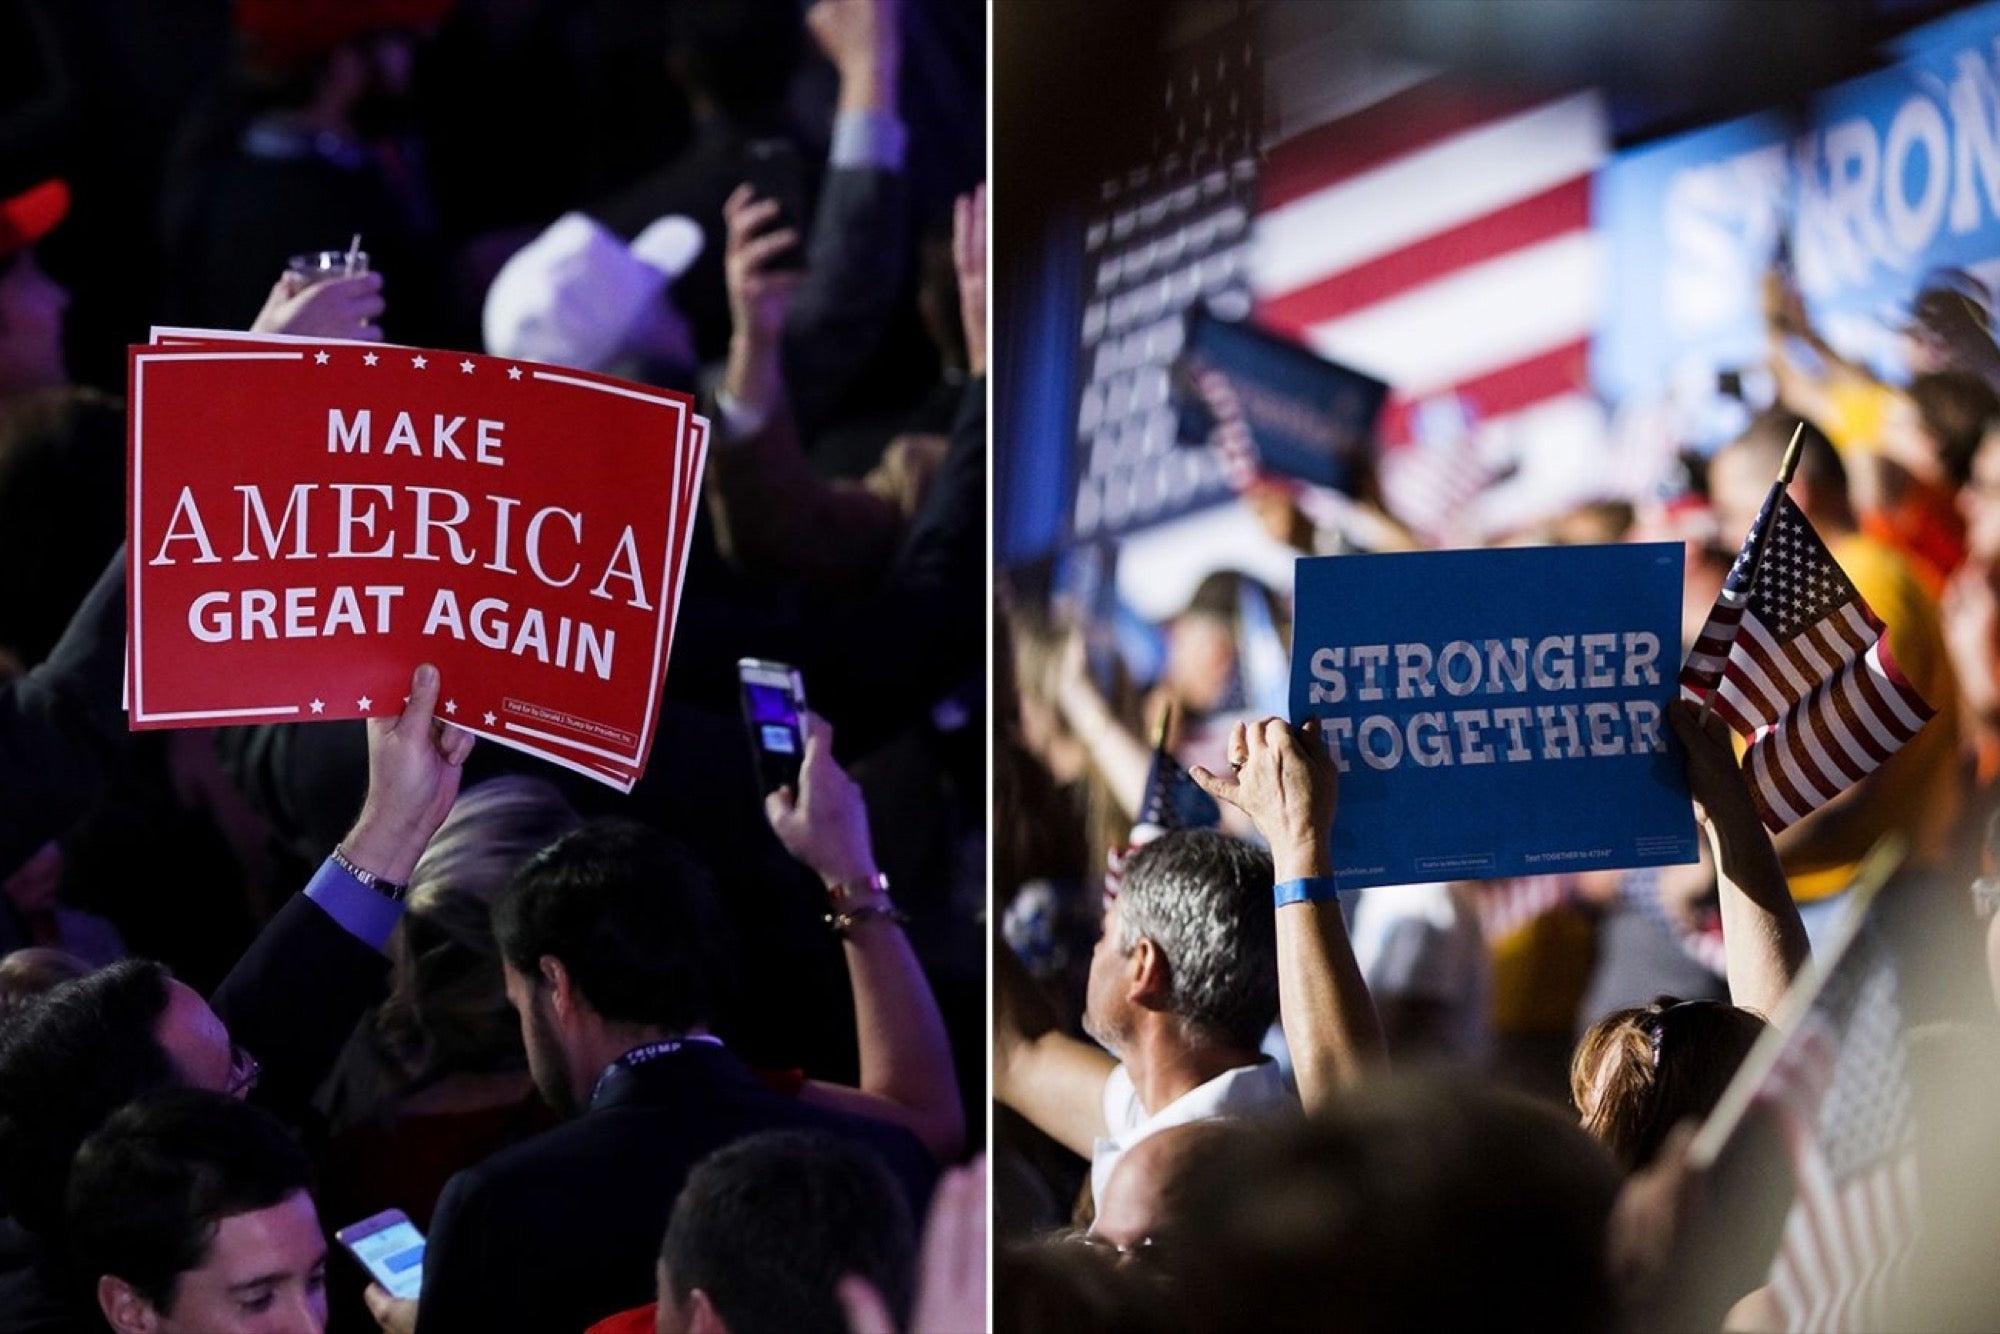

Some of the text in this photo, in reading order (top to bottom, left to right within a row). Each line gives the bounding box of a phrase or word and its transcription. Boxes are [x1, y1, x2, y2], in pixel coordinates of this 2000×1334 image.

[327, 408, 505, 466] MAKE
[149, 484, 654, 611] AMERICA
[188, 586, 616, 680] GREAT AGAIN
[1309, 631, 1661, 704] STRONGER
[1321, 700, 1667, 773] TOGETHER
[626, 1042, 682, 1060] TRUMP
